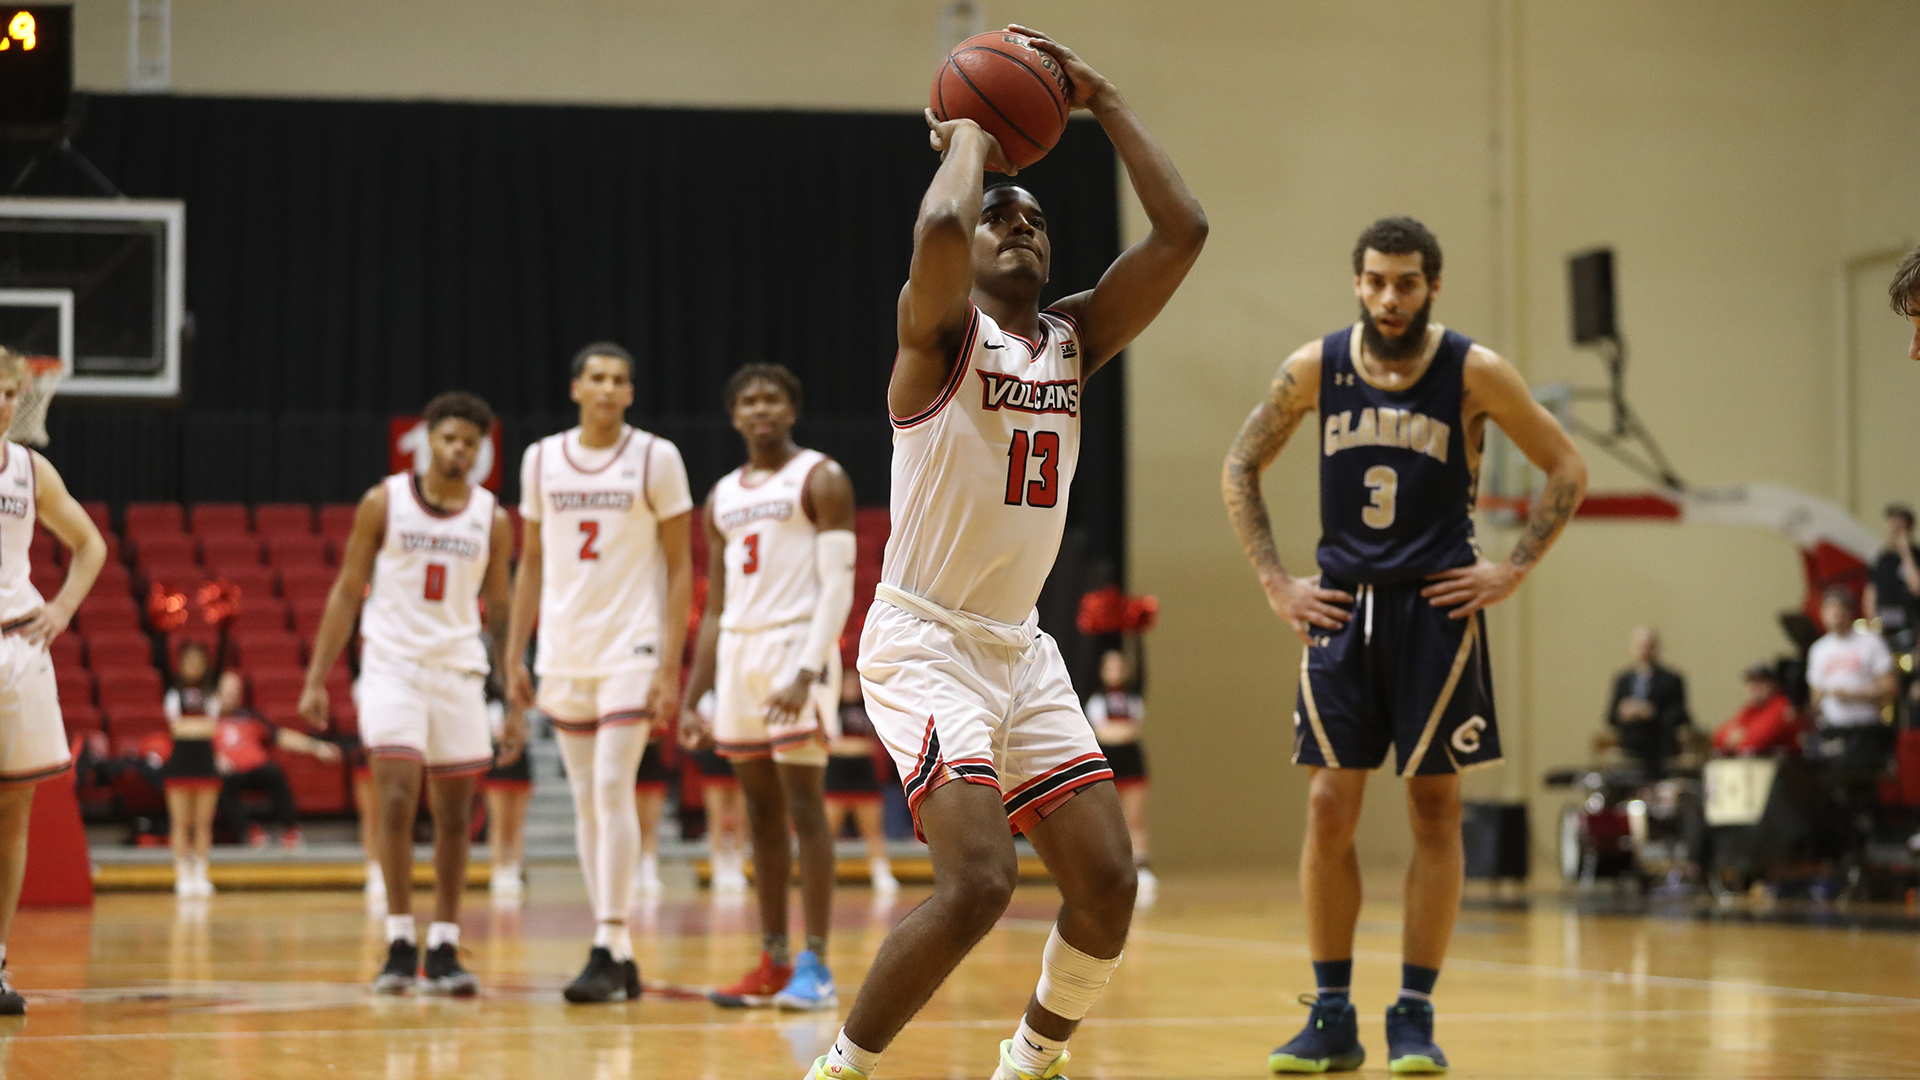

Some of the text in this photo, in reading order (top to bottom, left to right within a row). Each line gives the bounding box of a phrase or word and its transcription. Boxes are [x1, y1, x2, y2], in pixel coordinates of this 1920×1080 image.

[980, 371, 1078, 416] VULCANS
[1323, 406, 1450, 464] CLARION
[1004, 429, 1060, 508] 13
[1362, 464, 1398, 530] 3
[578, 520, 599, 560] 2
[743, 533, 760, 575] 3
[424, 563, 447, 602] 0
